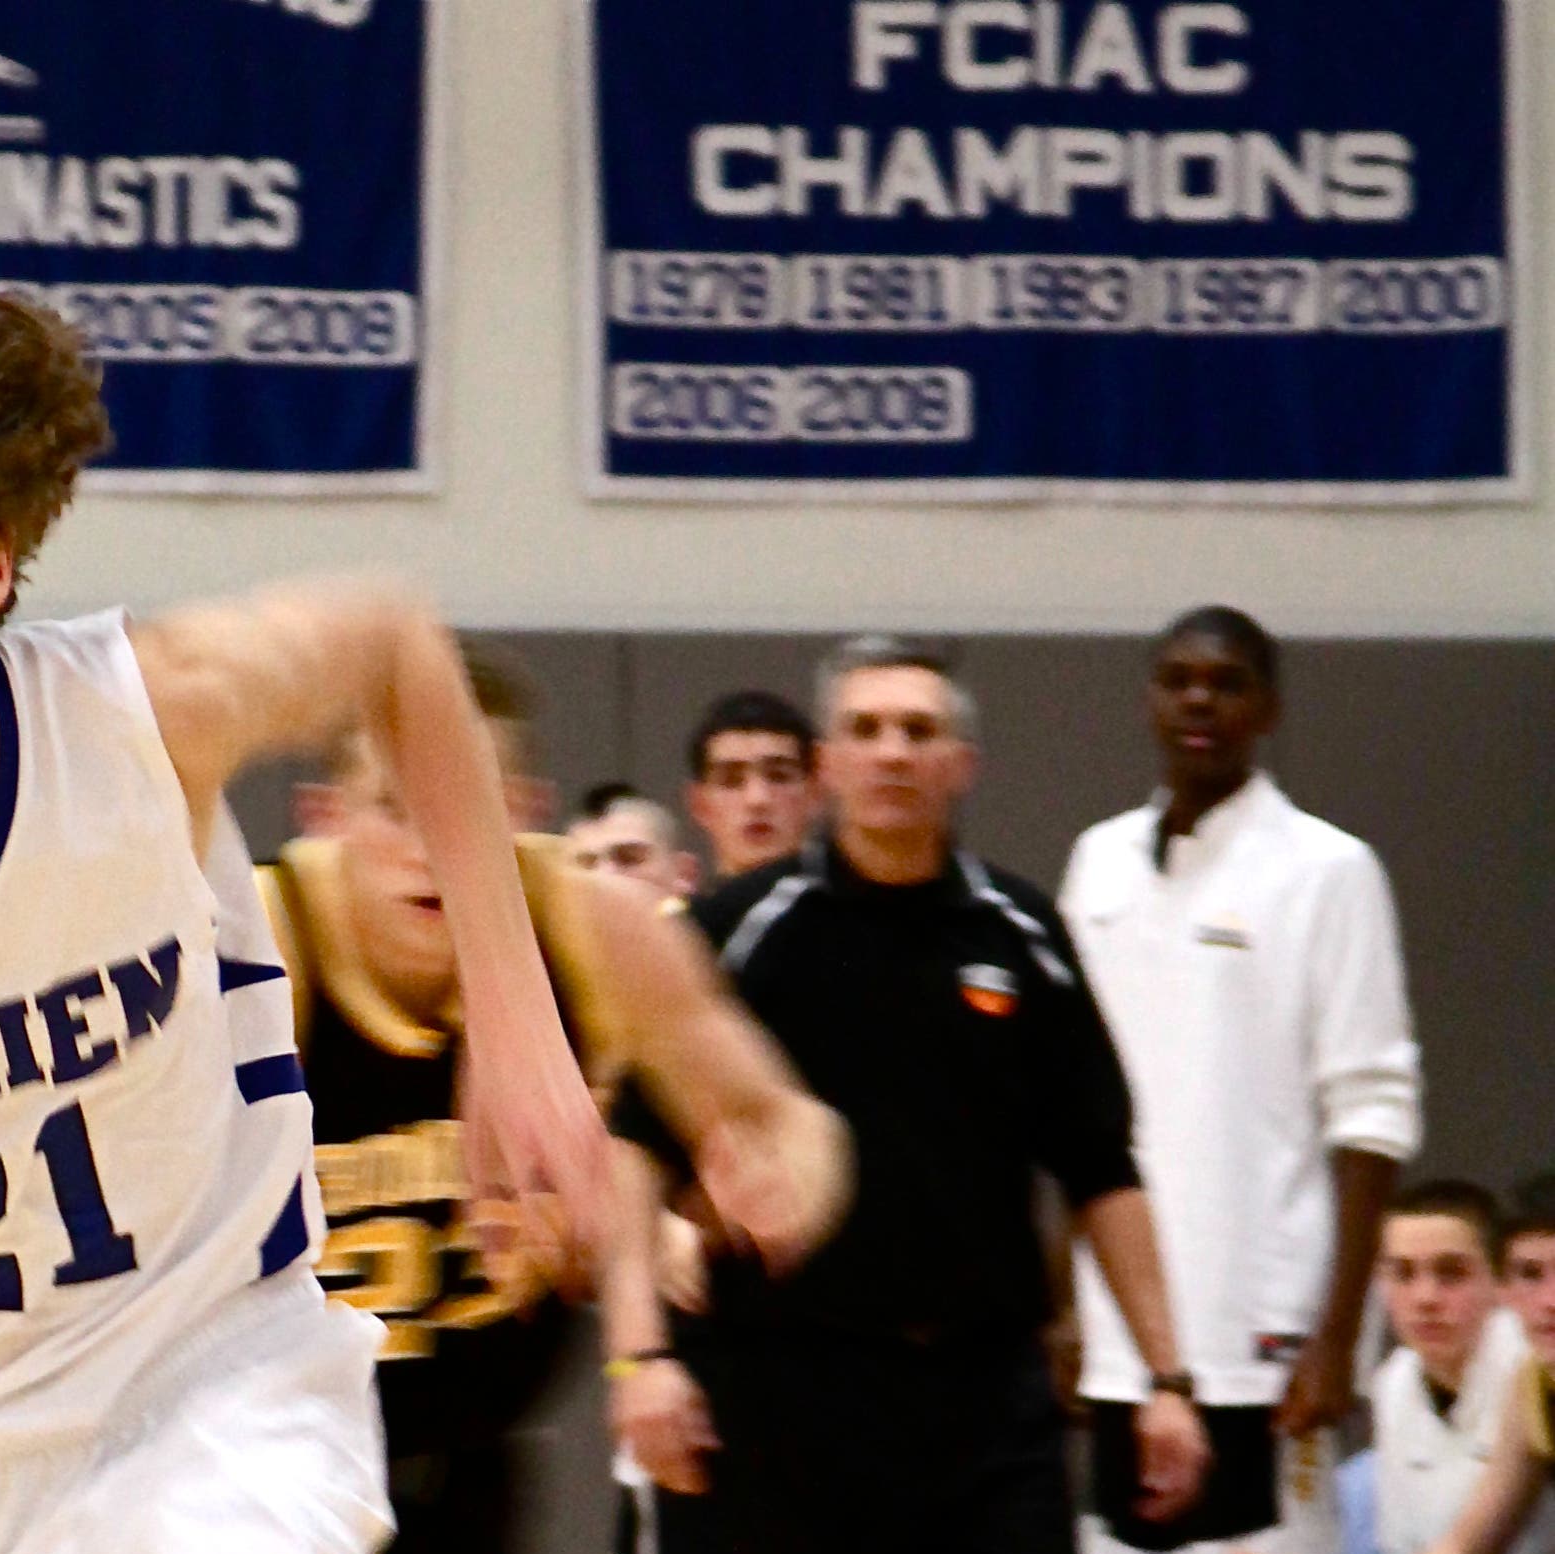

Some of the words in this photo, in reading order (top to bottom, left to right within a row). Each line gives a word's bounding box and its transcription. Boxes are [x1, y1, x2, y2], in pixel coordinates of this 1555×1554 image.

[851, 0, 1252, 95] FCIAC
[691, 124, 1415, 222] CHAMPIONS
[247, 295, 394, 354] 2008
[629, 259, 768, 320] 1978
[1343, 264, 1486, 325] 2000
